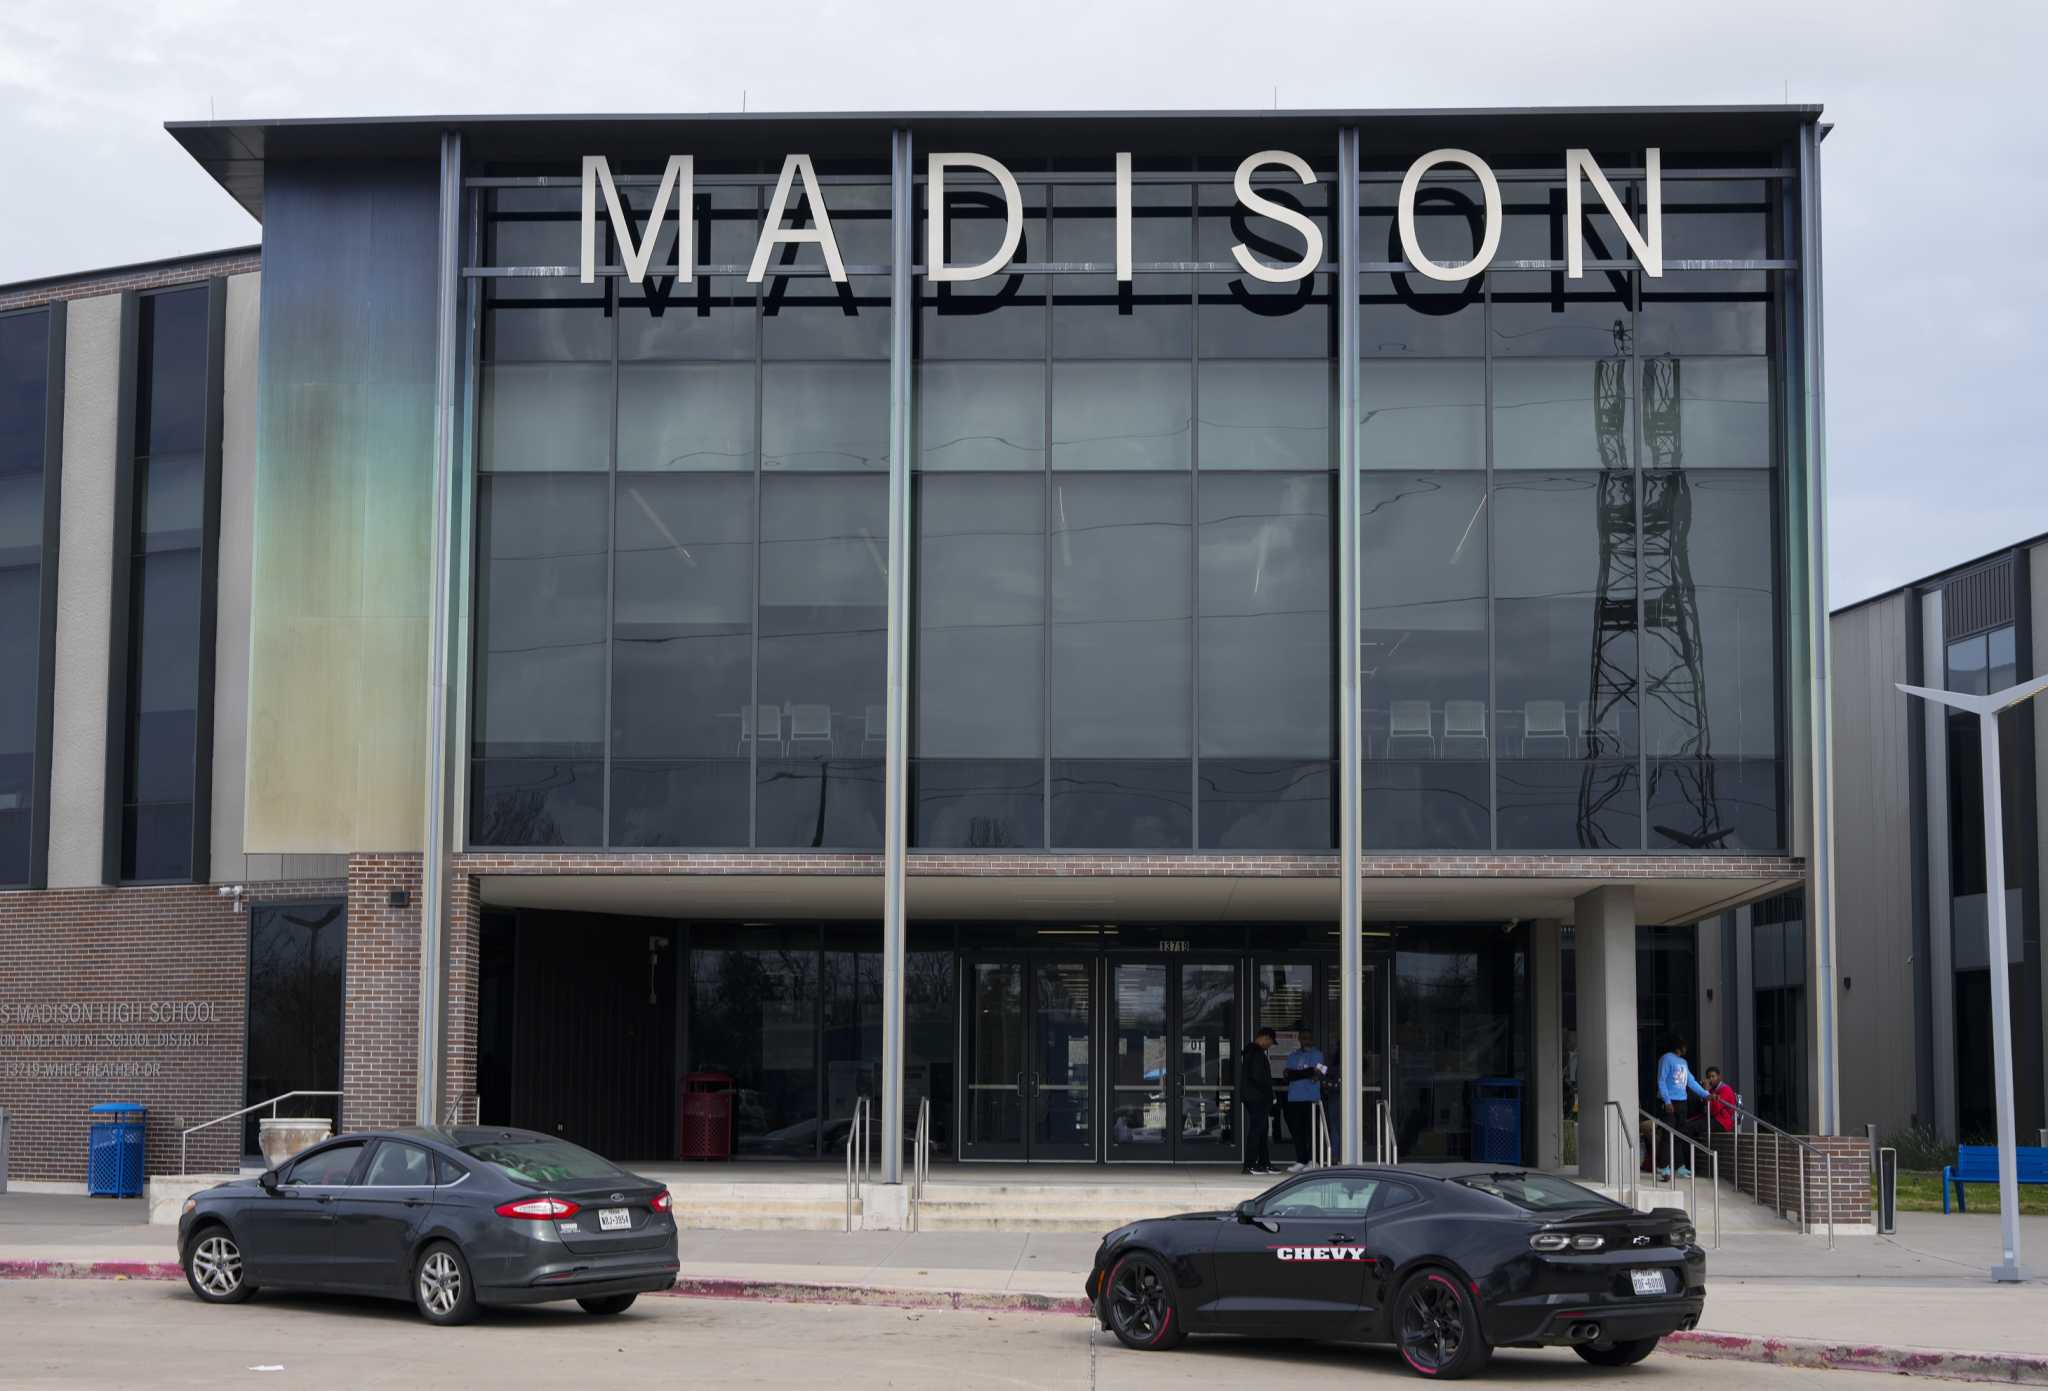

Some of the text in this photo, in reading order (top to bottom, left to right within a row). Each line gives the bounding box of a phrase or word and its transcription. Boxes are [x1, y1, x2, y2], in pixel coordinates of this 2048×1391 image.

[578, 147, 1664, 284] MADISON
[16, 1002, 93, 1023] MADISON
[99, 1001, 142, 1023] HIGH
[150, 1000, 220, 1023] SCHOOL
[20, 1033, 99, 1047] INDEPENDENT
[106, 1033, 152, 1047] SCHOOL
[158, 1032, 209, 1047] DISTRICT
[44, 1063, 80, 1077] WHITE
[84, 1063, 139, 1077] HEATHER
[144, 1063, 161, 1077] DR
[1277, 1247, 1365, 1260] CHEVY
